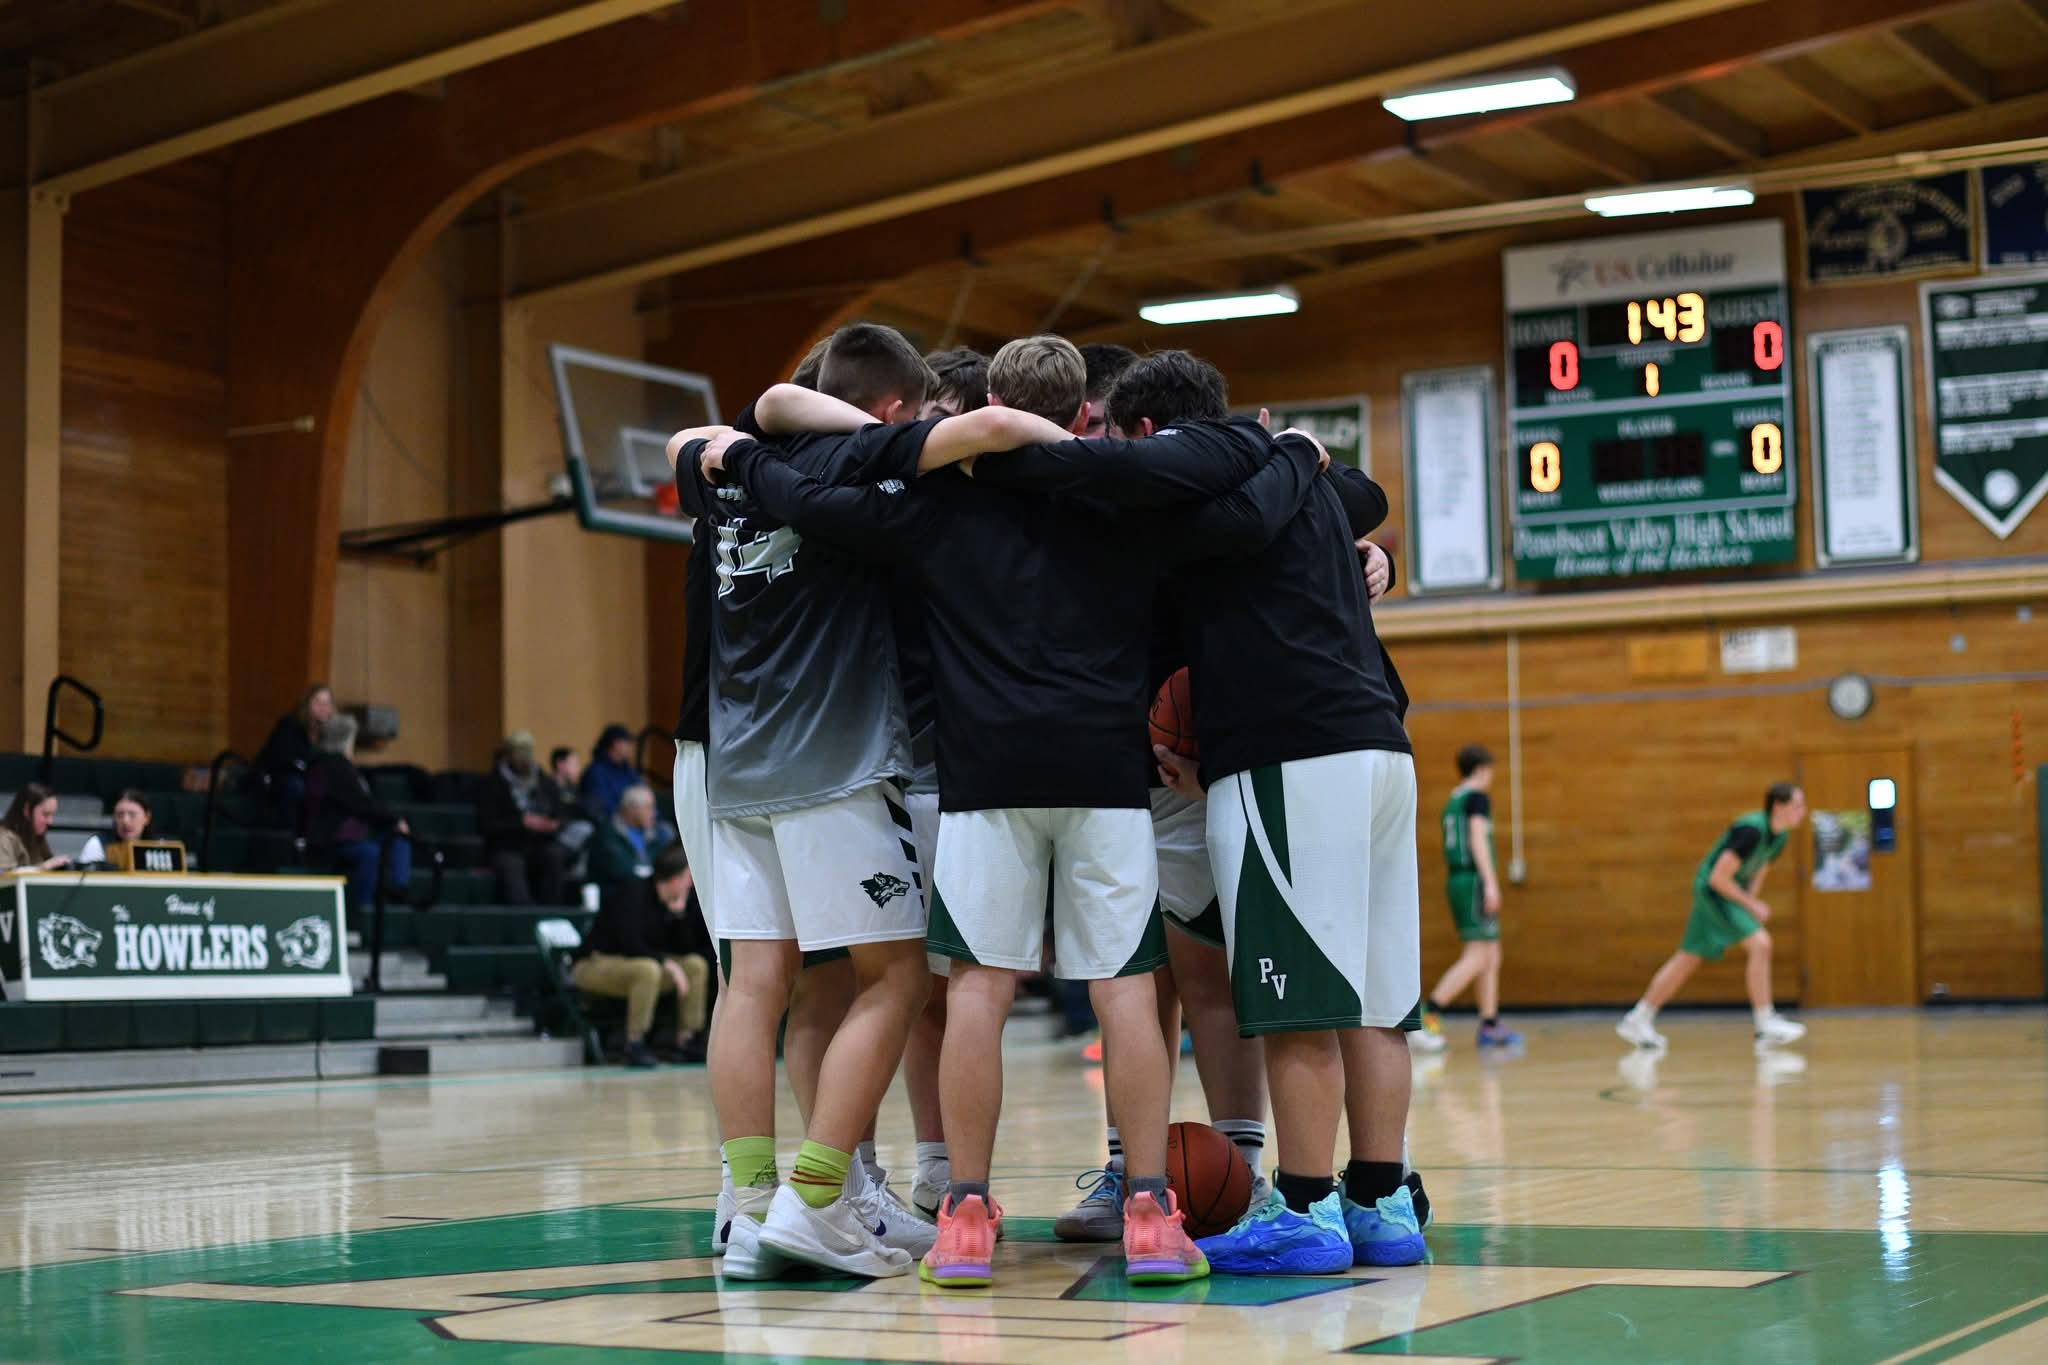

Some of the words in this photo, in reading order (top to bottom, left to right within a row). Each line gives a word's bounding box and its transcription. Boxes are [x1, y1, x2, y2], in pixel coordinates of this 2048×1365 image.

[1549, 340, 1579, 391] 0
[1753, 320, 1784, 370] 0
[1645, 362, 1660, 398] 1
[1530, 441, 1561, 493] 0
[1751, 422, 1782, 475] 0
[1609, 515, 1671, 552] Valley
[1674, 509, 1722, 548] High
[1724, 505, 1793, 543] School
[202, 895, 216, 922] of
[114, 923, 269, 971] HOWLERS
